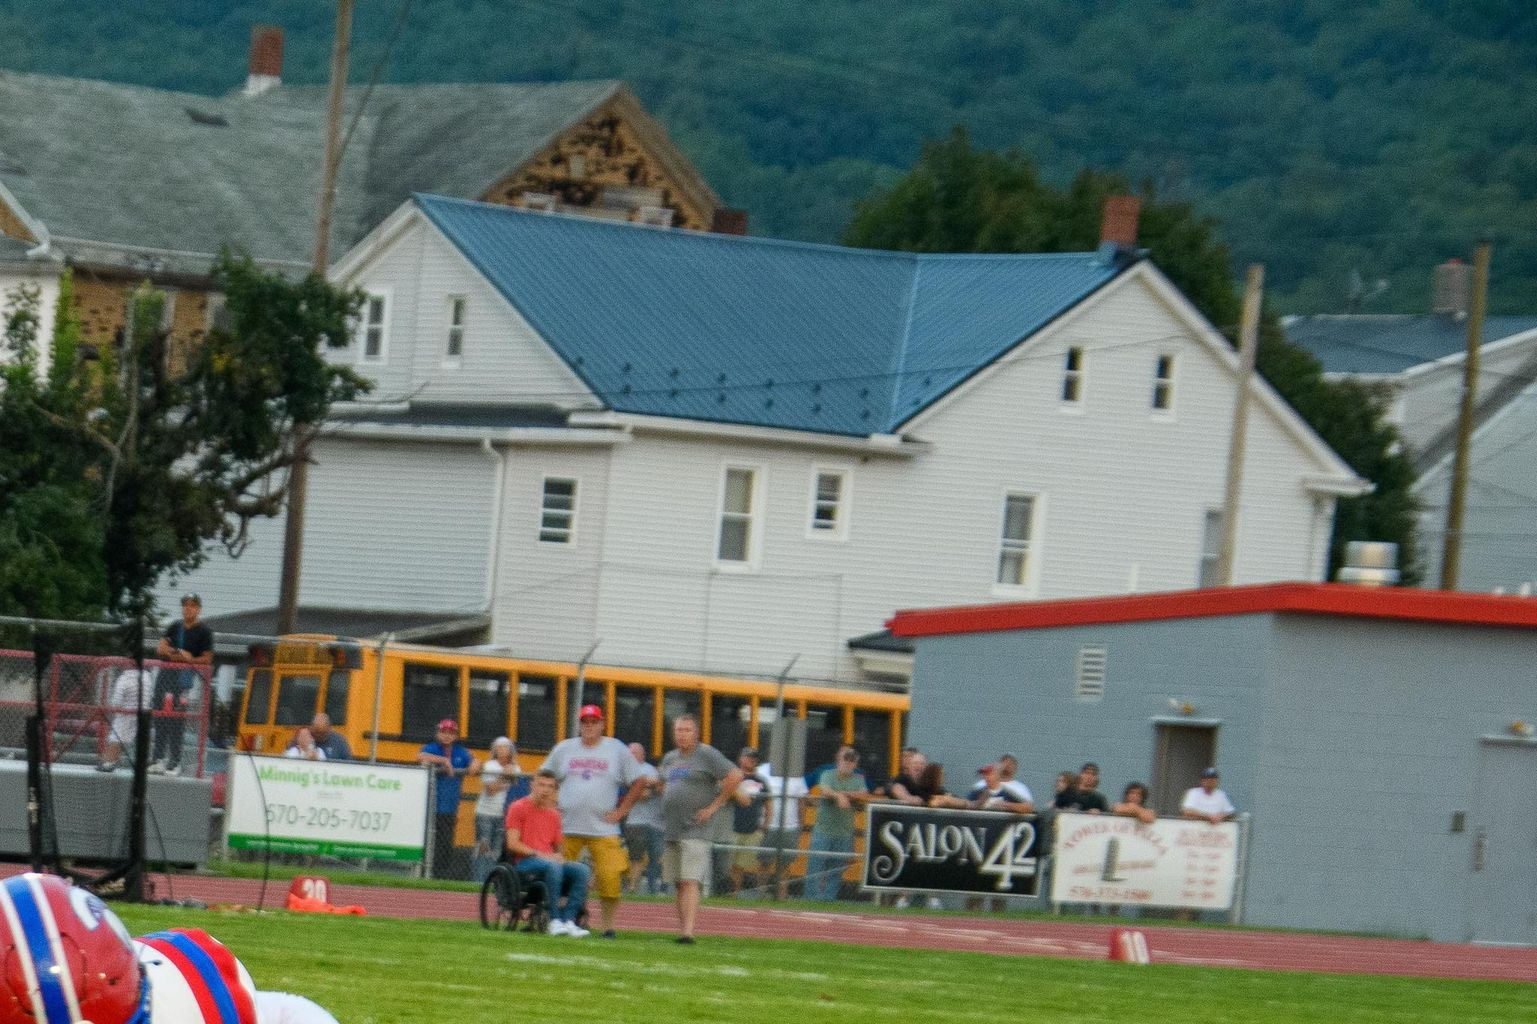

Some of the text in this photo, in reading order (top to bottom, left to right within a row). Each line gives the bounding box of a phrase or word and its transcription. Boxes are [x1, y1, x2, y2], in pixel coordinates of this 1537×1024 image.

[260, 764, 402, 791] Minnig's Lawn Care
[872, 820, 1037, 890] SALON 42
